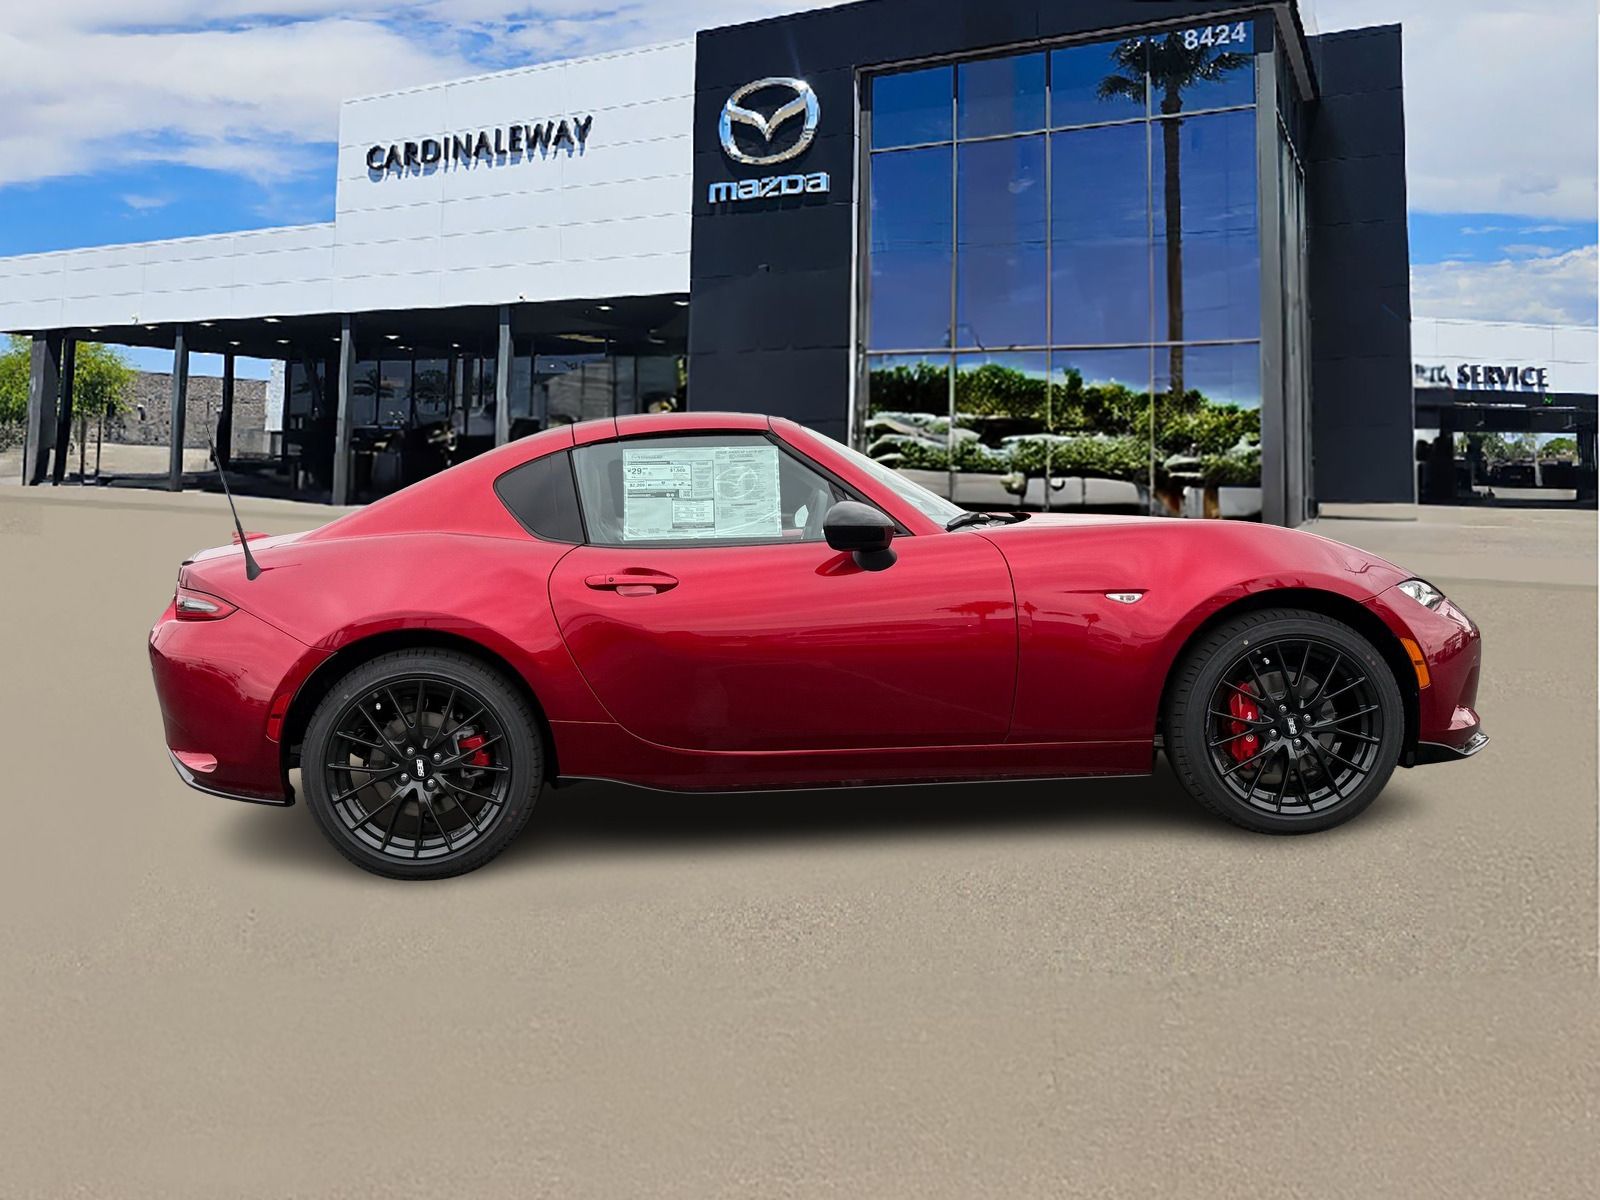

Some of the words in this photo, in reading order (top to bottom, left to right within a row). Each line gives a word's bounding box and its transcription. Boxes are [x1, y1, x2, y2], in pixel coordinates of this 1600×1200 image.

[1184, 22, 1247, 50] 8424
[366, 114, 593, 171] CARDINALEWAY
[1457, 363, 1550, 388] SERVICE
